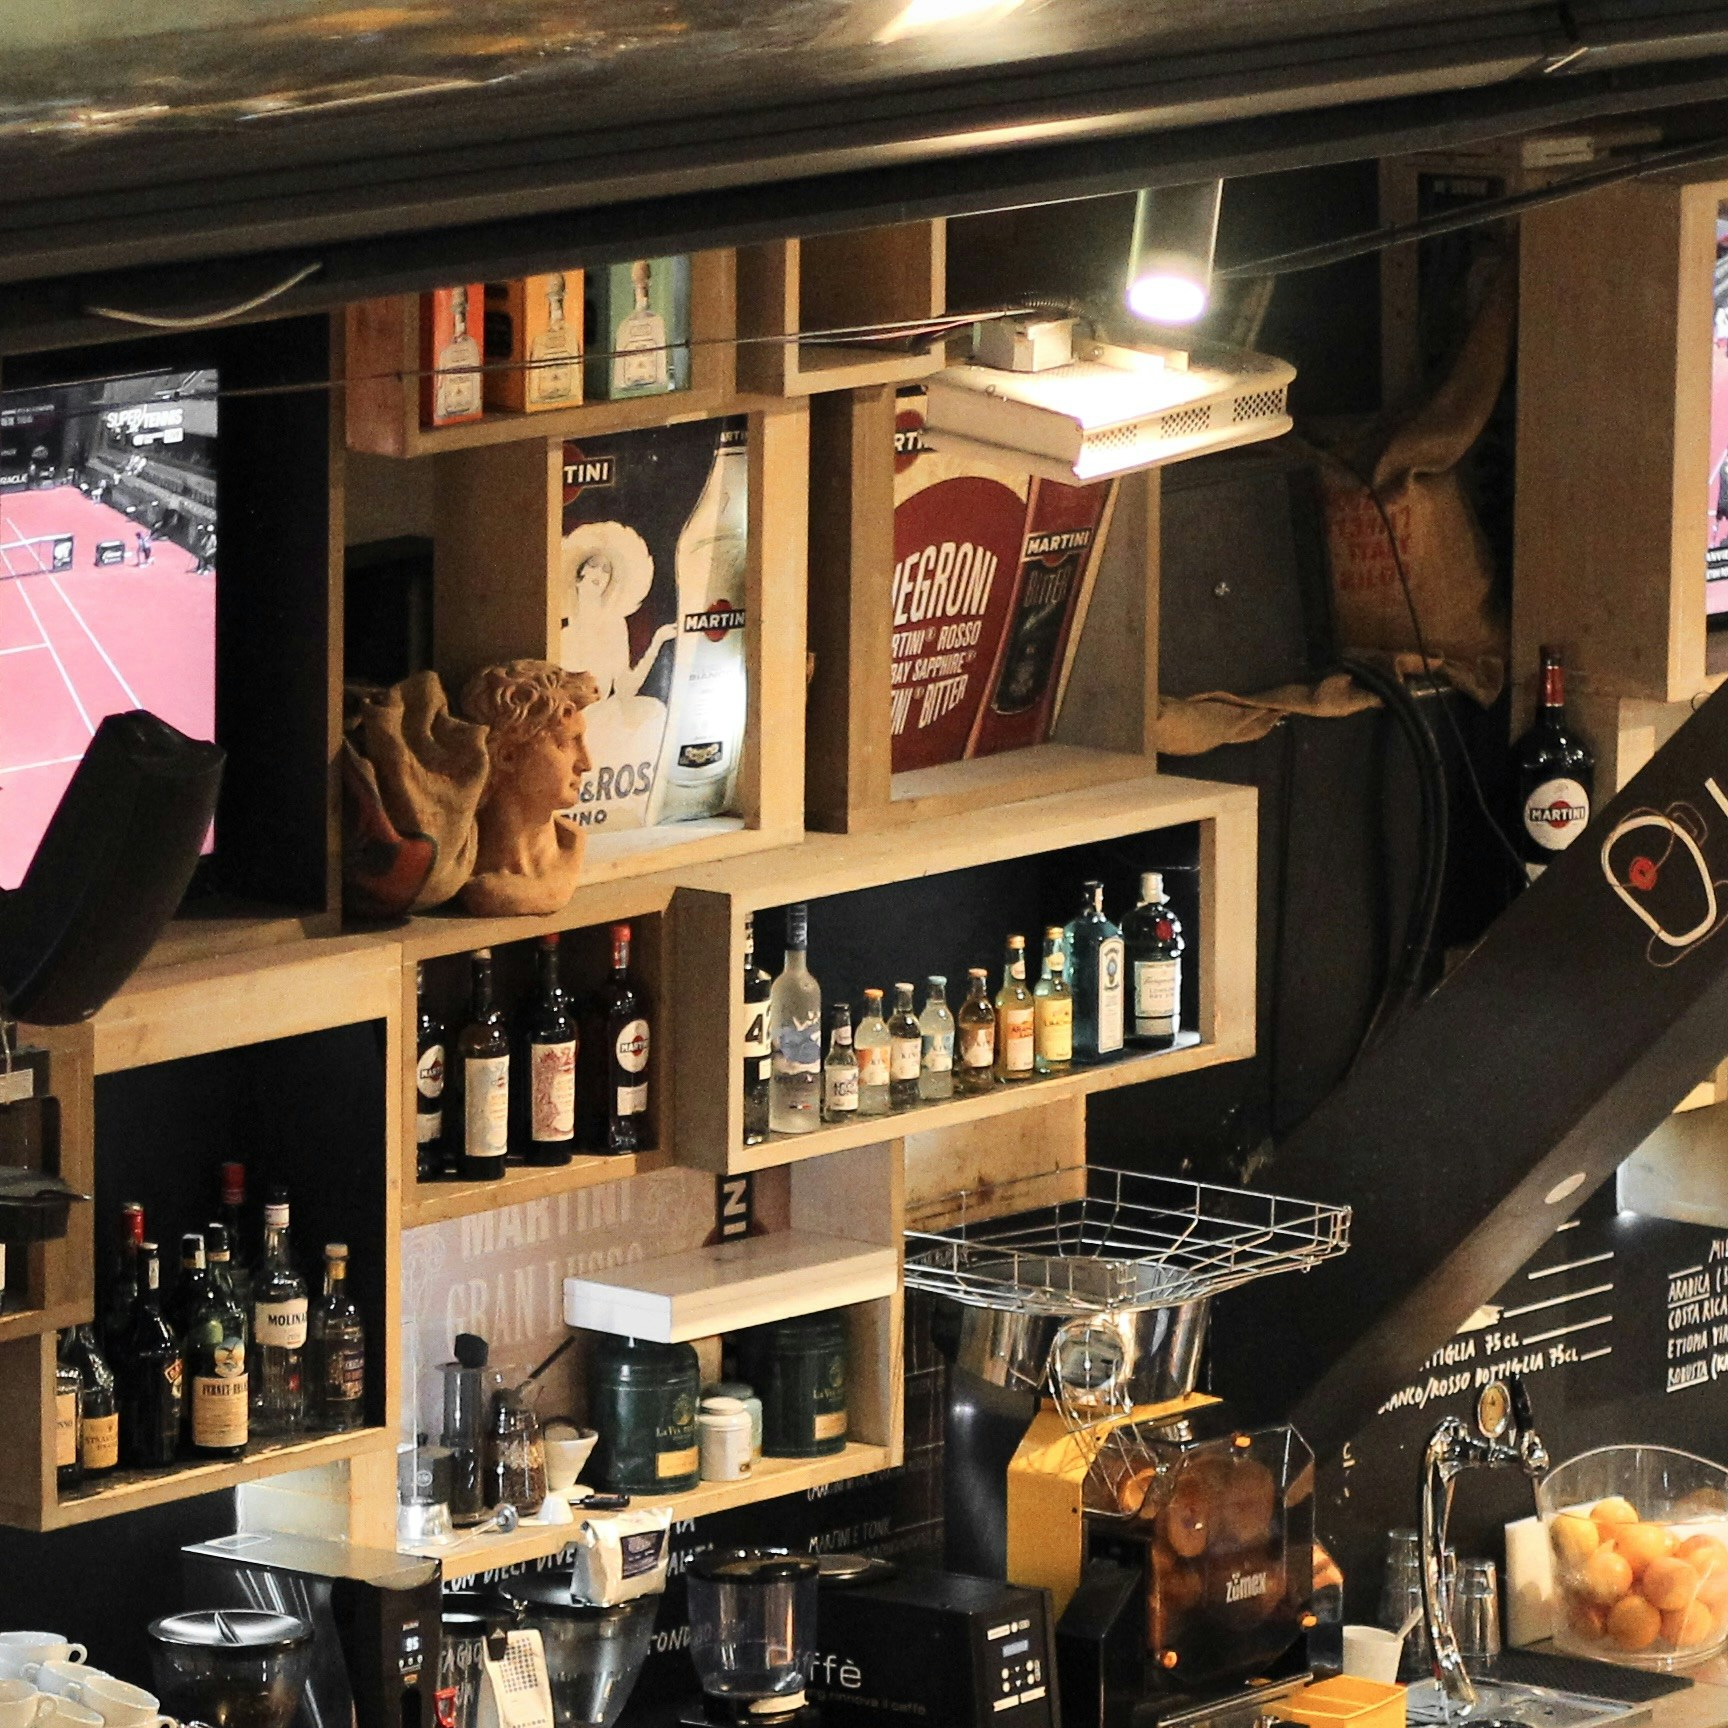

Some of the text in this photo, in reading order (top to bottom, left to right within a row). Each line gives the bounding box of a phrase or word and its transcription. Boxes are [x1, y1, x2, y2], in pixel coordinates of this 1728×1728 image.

[1027, 531, 1091, 556] MARTINI
[936, 620, 983, 652] ROSSO
[1531, 806, 1586, 822] MARTINI
[1668, 1272, 1711, 1303] ARABICA
[1668, 1307, 1700, 1332] COSTA
[1702, 1293, 1728, 1323] RICA
[1667, 1329, 1709, 1359] ETIOPIA
